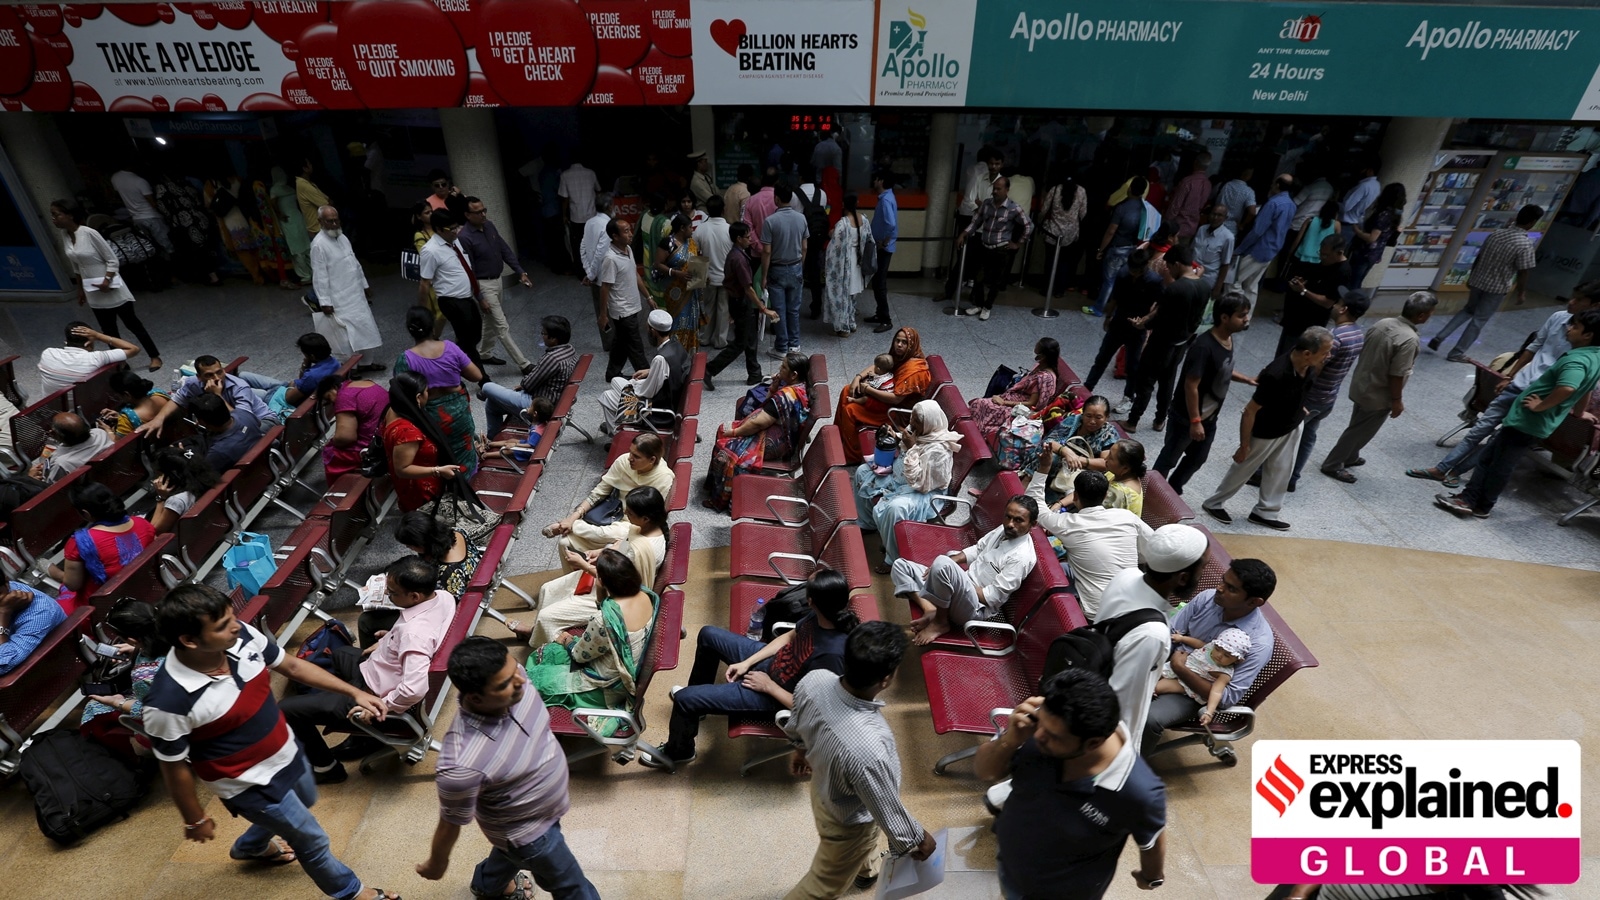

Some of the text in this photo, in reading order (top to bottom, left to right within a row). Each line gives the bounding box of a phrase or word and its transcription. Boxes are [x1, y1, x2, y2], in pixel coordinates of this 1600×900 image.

[262, 1, 279, 14] EAT
[280, 1, 319, 14] HEALTHY
[655, 10, 676, 19] PLEDGE
[590, 12, 621, 25] PLEDGE
[659, 19, 674, 29] QUIT
[596, 25, 642, 39] EXERCISE
[1009, 11, 1183, 52] Apollo PHARMACY
[1279, 14, 1321, 40] atm
[489, 31, 533, 46] I PLEDGE
[739, 33, 858, 49] BILLION HEARTS
[1405, 20, 1580, 61] Apollo PHARMACY
[96, 41, 261, 73] TAKE A PLEDGE
[352, 43, 400, 59] I PLEDGE
[491, 46, 576, 64] TO GET A HEART
[308, 57, 335, 68] PLEDGE
[356, 59, 456, 78] TO QUIT SMOKING
[739, 52, 816, 71] BEATING
[315, 67, 331, 80] GET
[331, 67, 339, 80] A
[524, 64, 564, 81] CHECK
[641, 67, 662, 75] PLEDGE
[881, 52, 960, 89] Apollo
[1248, 62, 1325, 80] 24 Hours
[124, 76, 265, 88] www.billionheartsbeating.com
[645, 75, 659, 85] GET
[664, 74, 686, 85] HEART
[906, 80, 959, 90] PHARMACY
[289, 88, 309, 97] PLEDGE
[656, 84, 678, 94] CHECK
[1252, 89, 1309, 102] New Delhi
